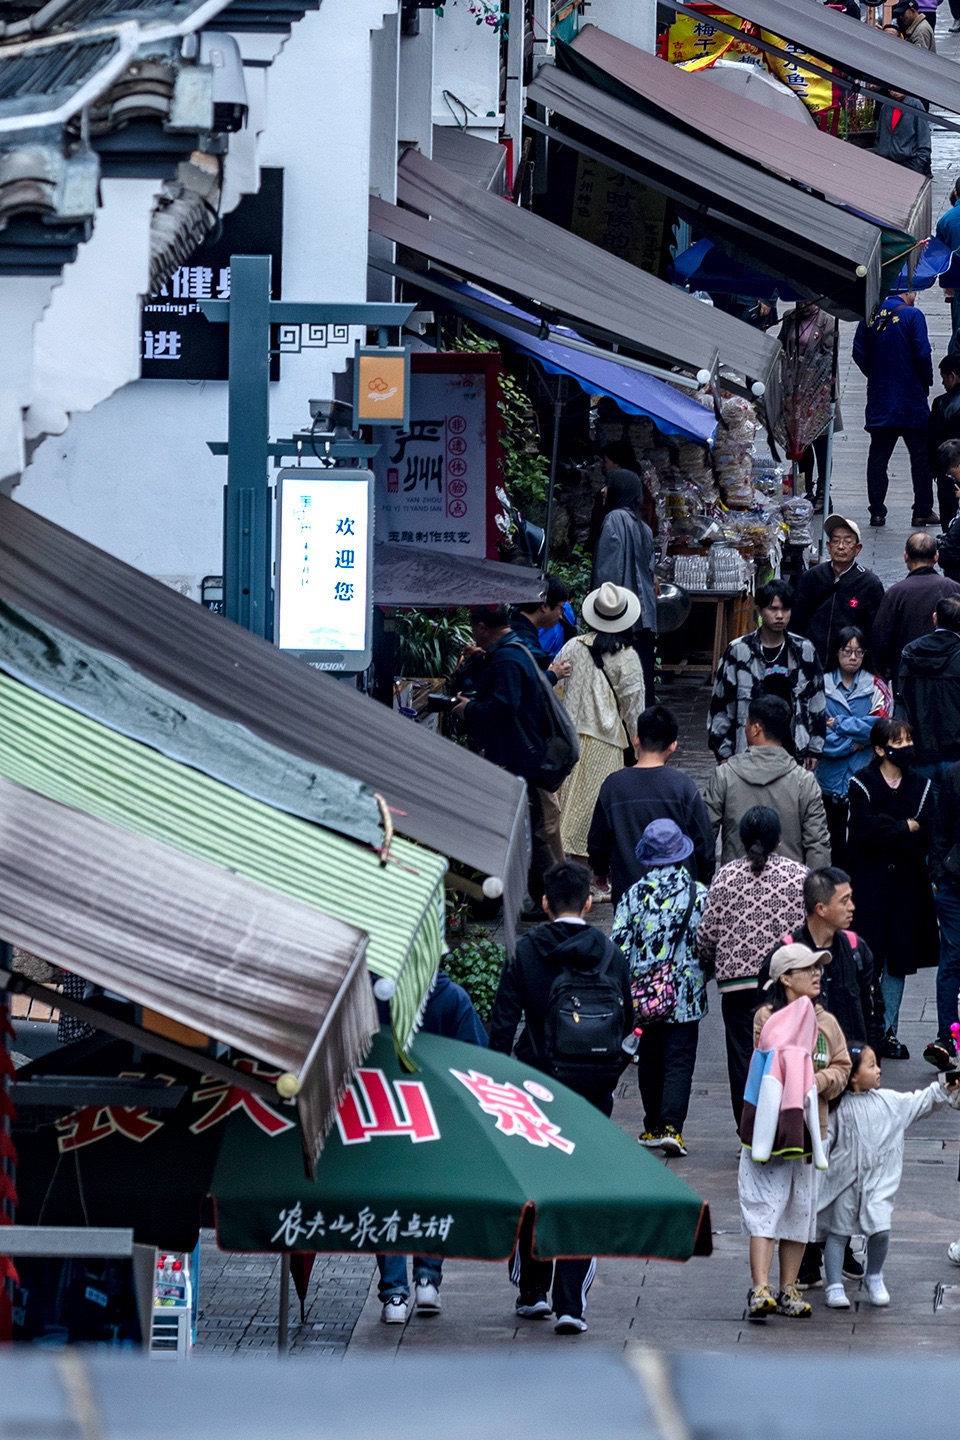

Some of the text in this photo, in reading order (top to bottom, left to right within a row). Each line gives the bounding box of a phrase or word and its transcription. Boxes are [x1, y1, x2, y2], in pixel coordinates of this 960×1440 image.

[140, 331, 181, 359] 进
[450, 417, 466, 516] 非遗体验点
[334, 517, 355, 601] 欢迎您
[270, 1200, 455, 1249] 农夫山泉有点甜
